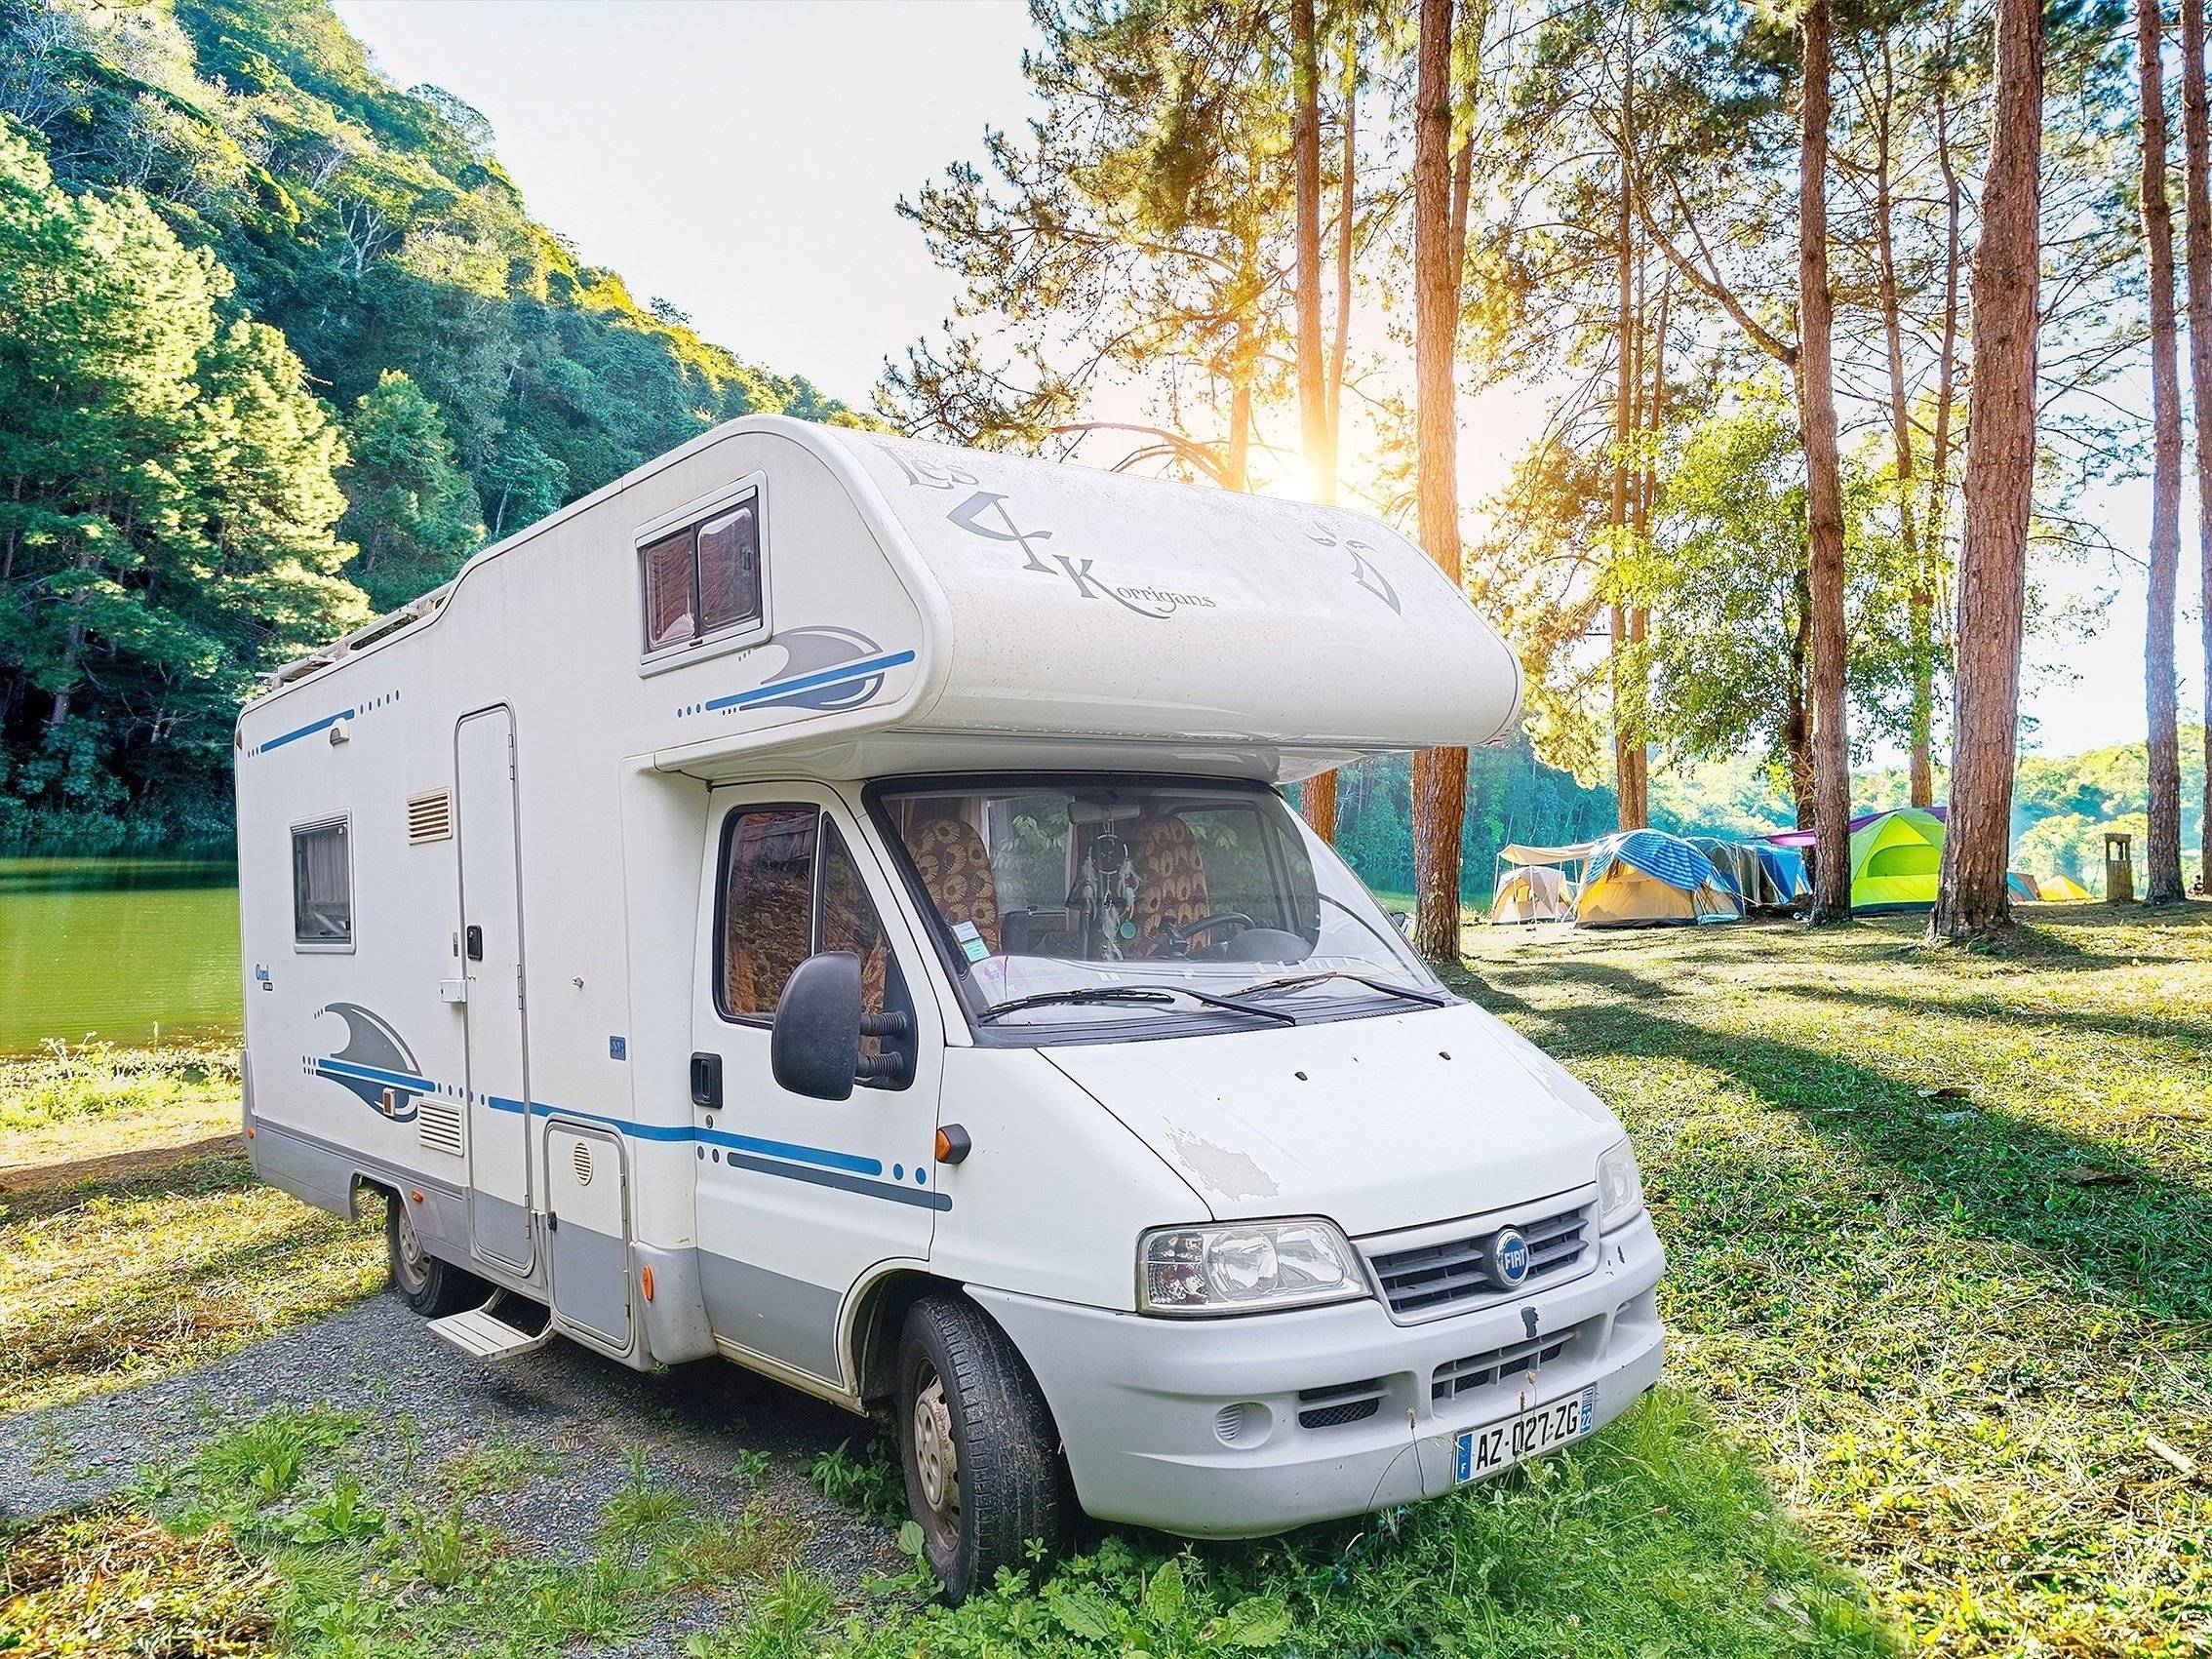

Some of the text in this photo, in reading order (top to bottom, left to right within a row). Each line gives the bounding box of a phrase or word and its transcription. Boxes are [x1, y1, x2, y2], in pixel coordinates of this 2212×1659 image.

[873, 445, 979, 490] Les
[1052, 554, 1216, 619] Korrigans
[1504, 1248, 1525, 1270] FIAT
[1461, 1462, 1467, 1474] F
[1580, 1410, 1592, 1429] 22
